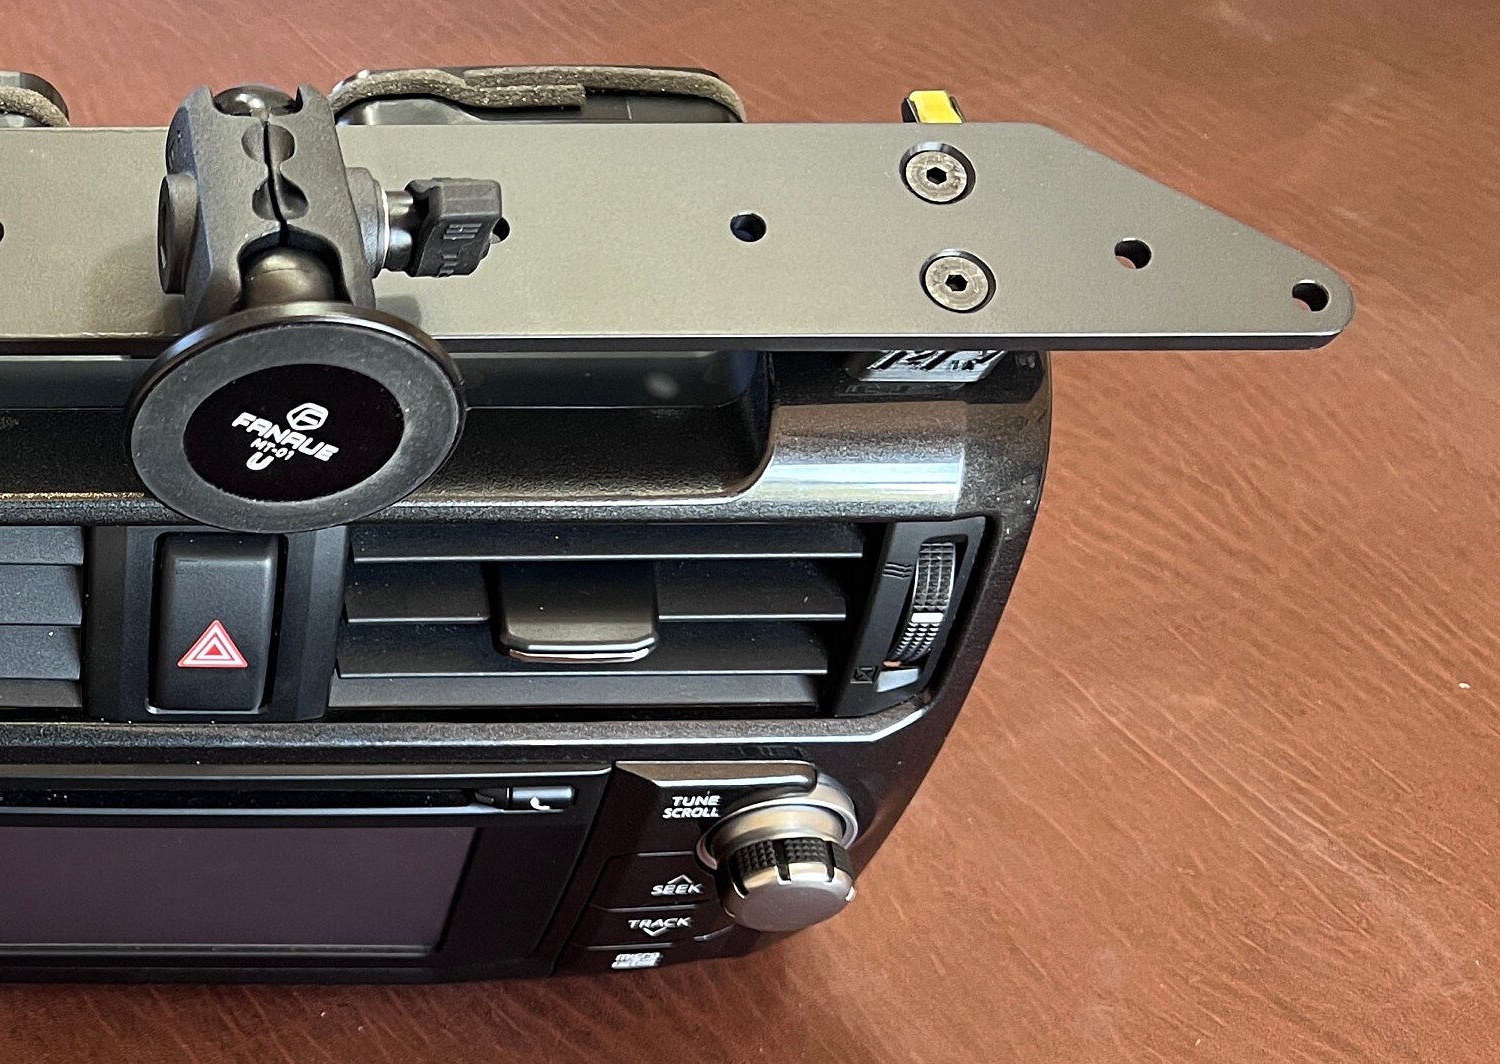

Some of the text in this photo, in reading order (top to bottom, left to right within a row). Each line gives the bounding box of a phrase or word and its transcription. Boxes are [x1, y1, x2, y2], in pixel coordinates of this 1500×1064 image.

[231, 411, 340, 462] FANAUE
[249, 437, 295, 461] MT-01
[671, 795, 721, 807] TUNE
[662, 806, 720, 819] SCROLL
[650, 883, 704, 896] SEEK
[627, 917, 693, 929] TRACK
